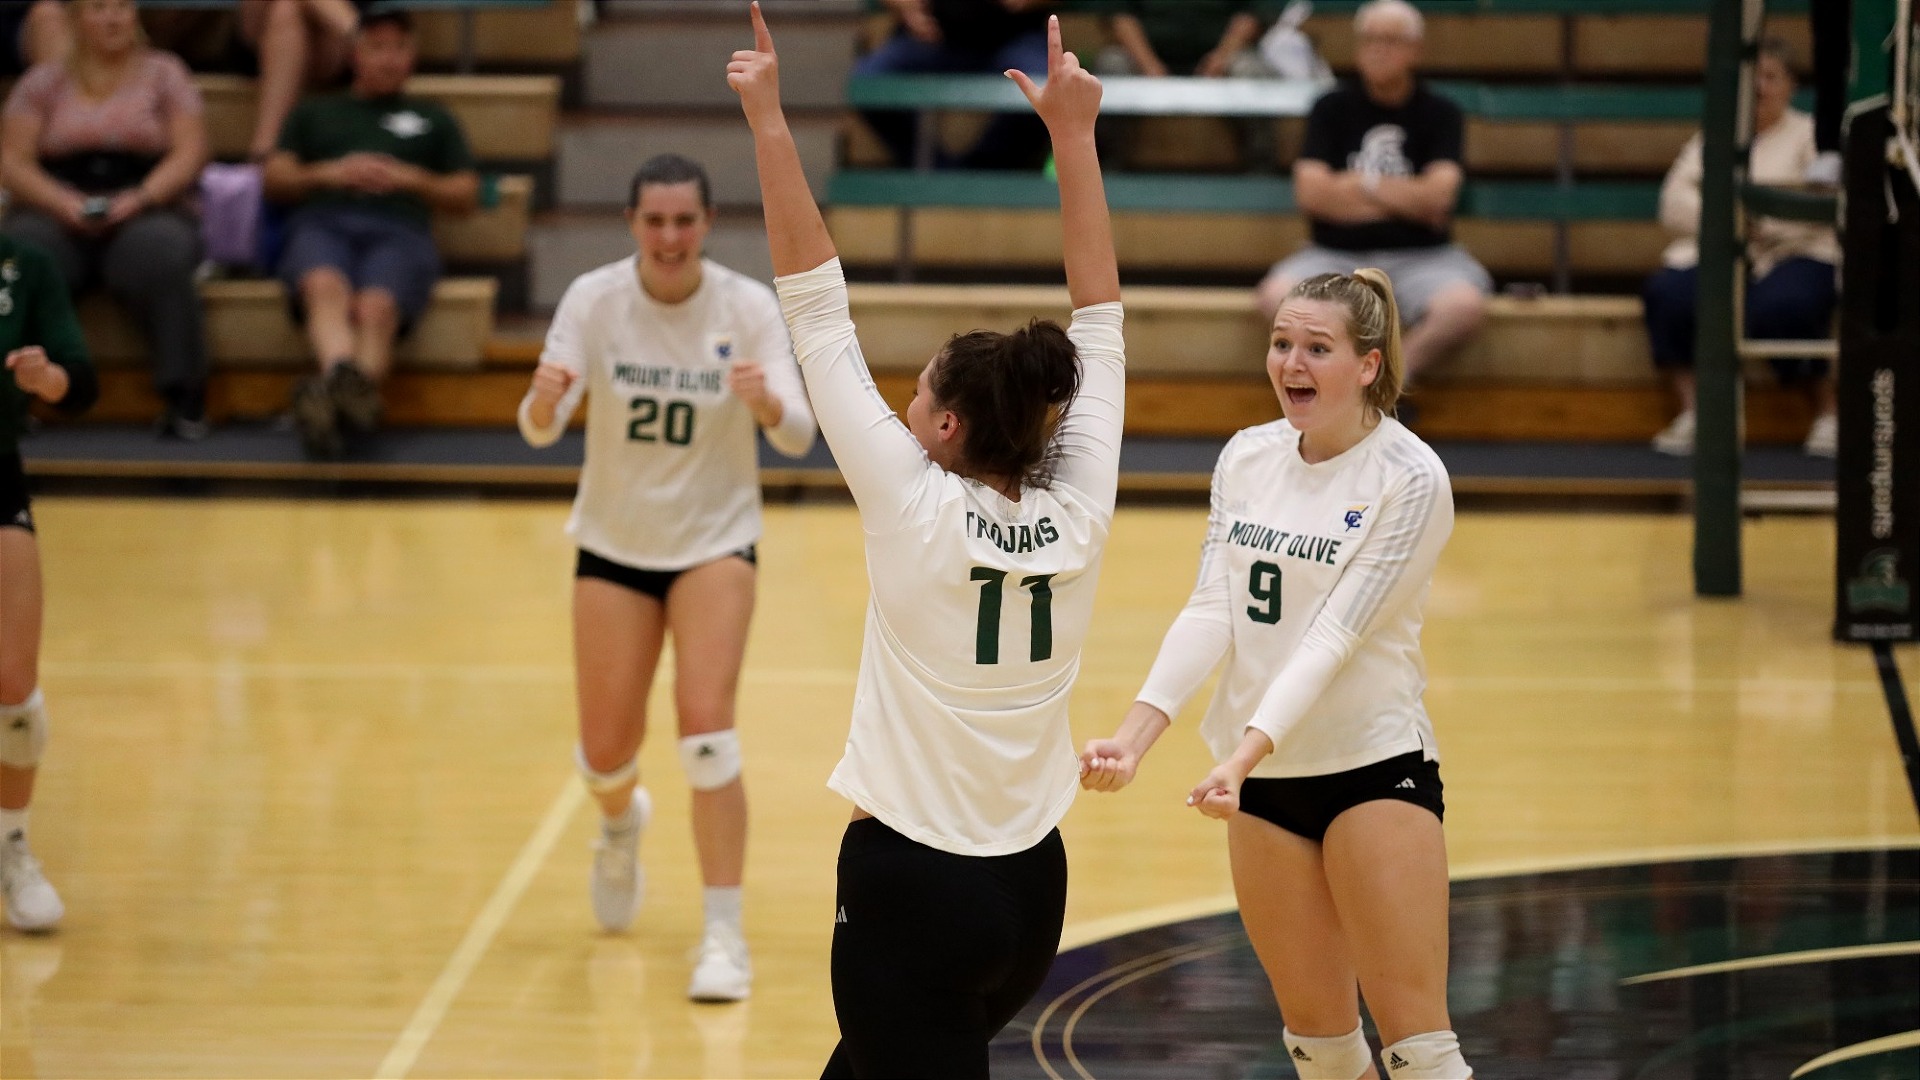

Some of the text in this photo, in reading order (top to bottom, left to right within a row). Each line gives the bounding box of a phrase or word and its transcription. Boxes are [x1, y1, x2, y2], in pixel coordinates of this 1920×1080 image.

[627, 396, 694, 446] 20
[966, 511, 1060, 554] TROJANS
[1227, 520, 1342, 566] MOUNT OLIVE
[969, 566, 1059, 665] 11
[1246, 559, 1282, 625] 9
